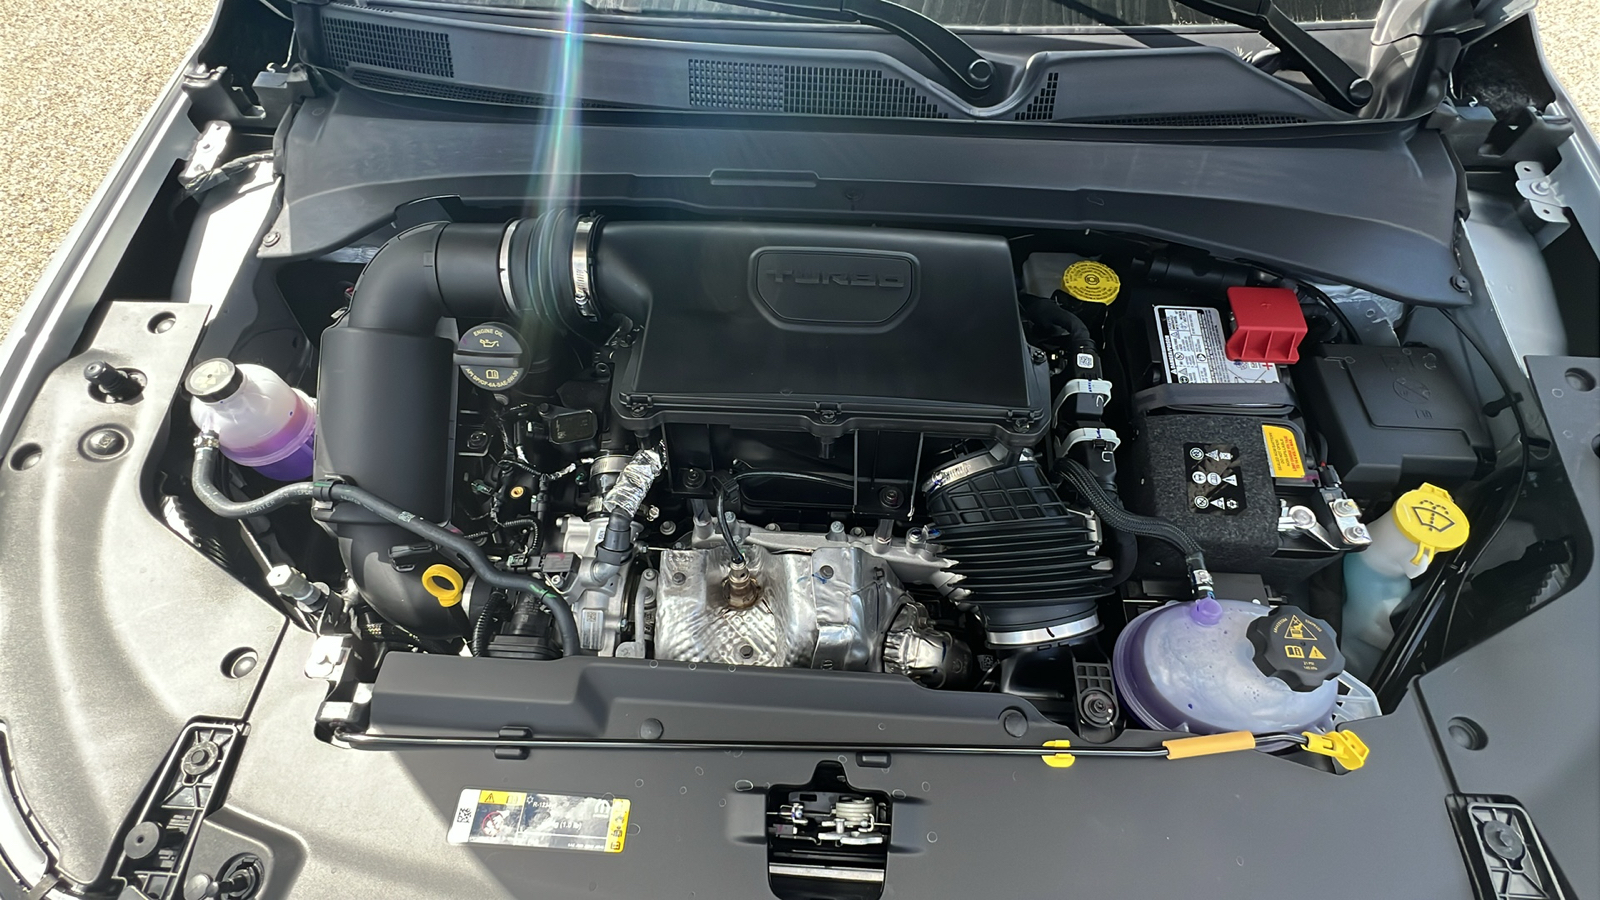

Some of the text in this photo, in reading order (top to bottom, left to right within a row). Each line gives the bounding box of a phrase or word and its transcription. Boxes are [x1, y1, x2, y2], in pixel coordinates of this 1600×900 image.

[766, 269, 905, 288] TURBO
[473, 328, 504, 338] ENGINE OIL
[245, 500, 275, 514] HEATER
